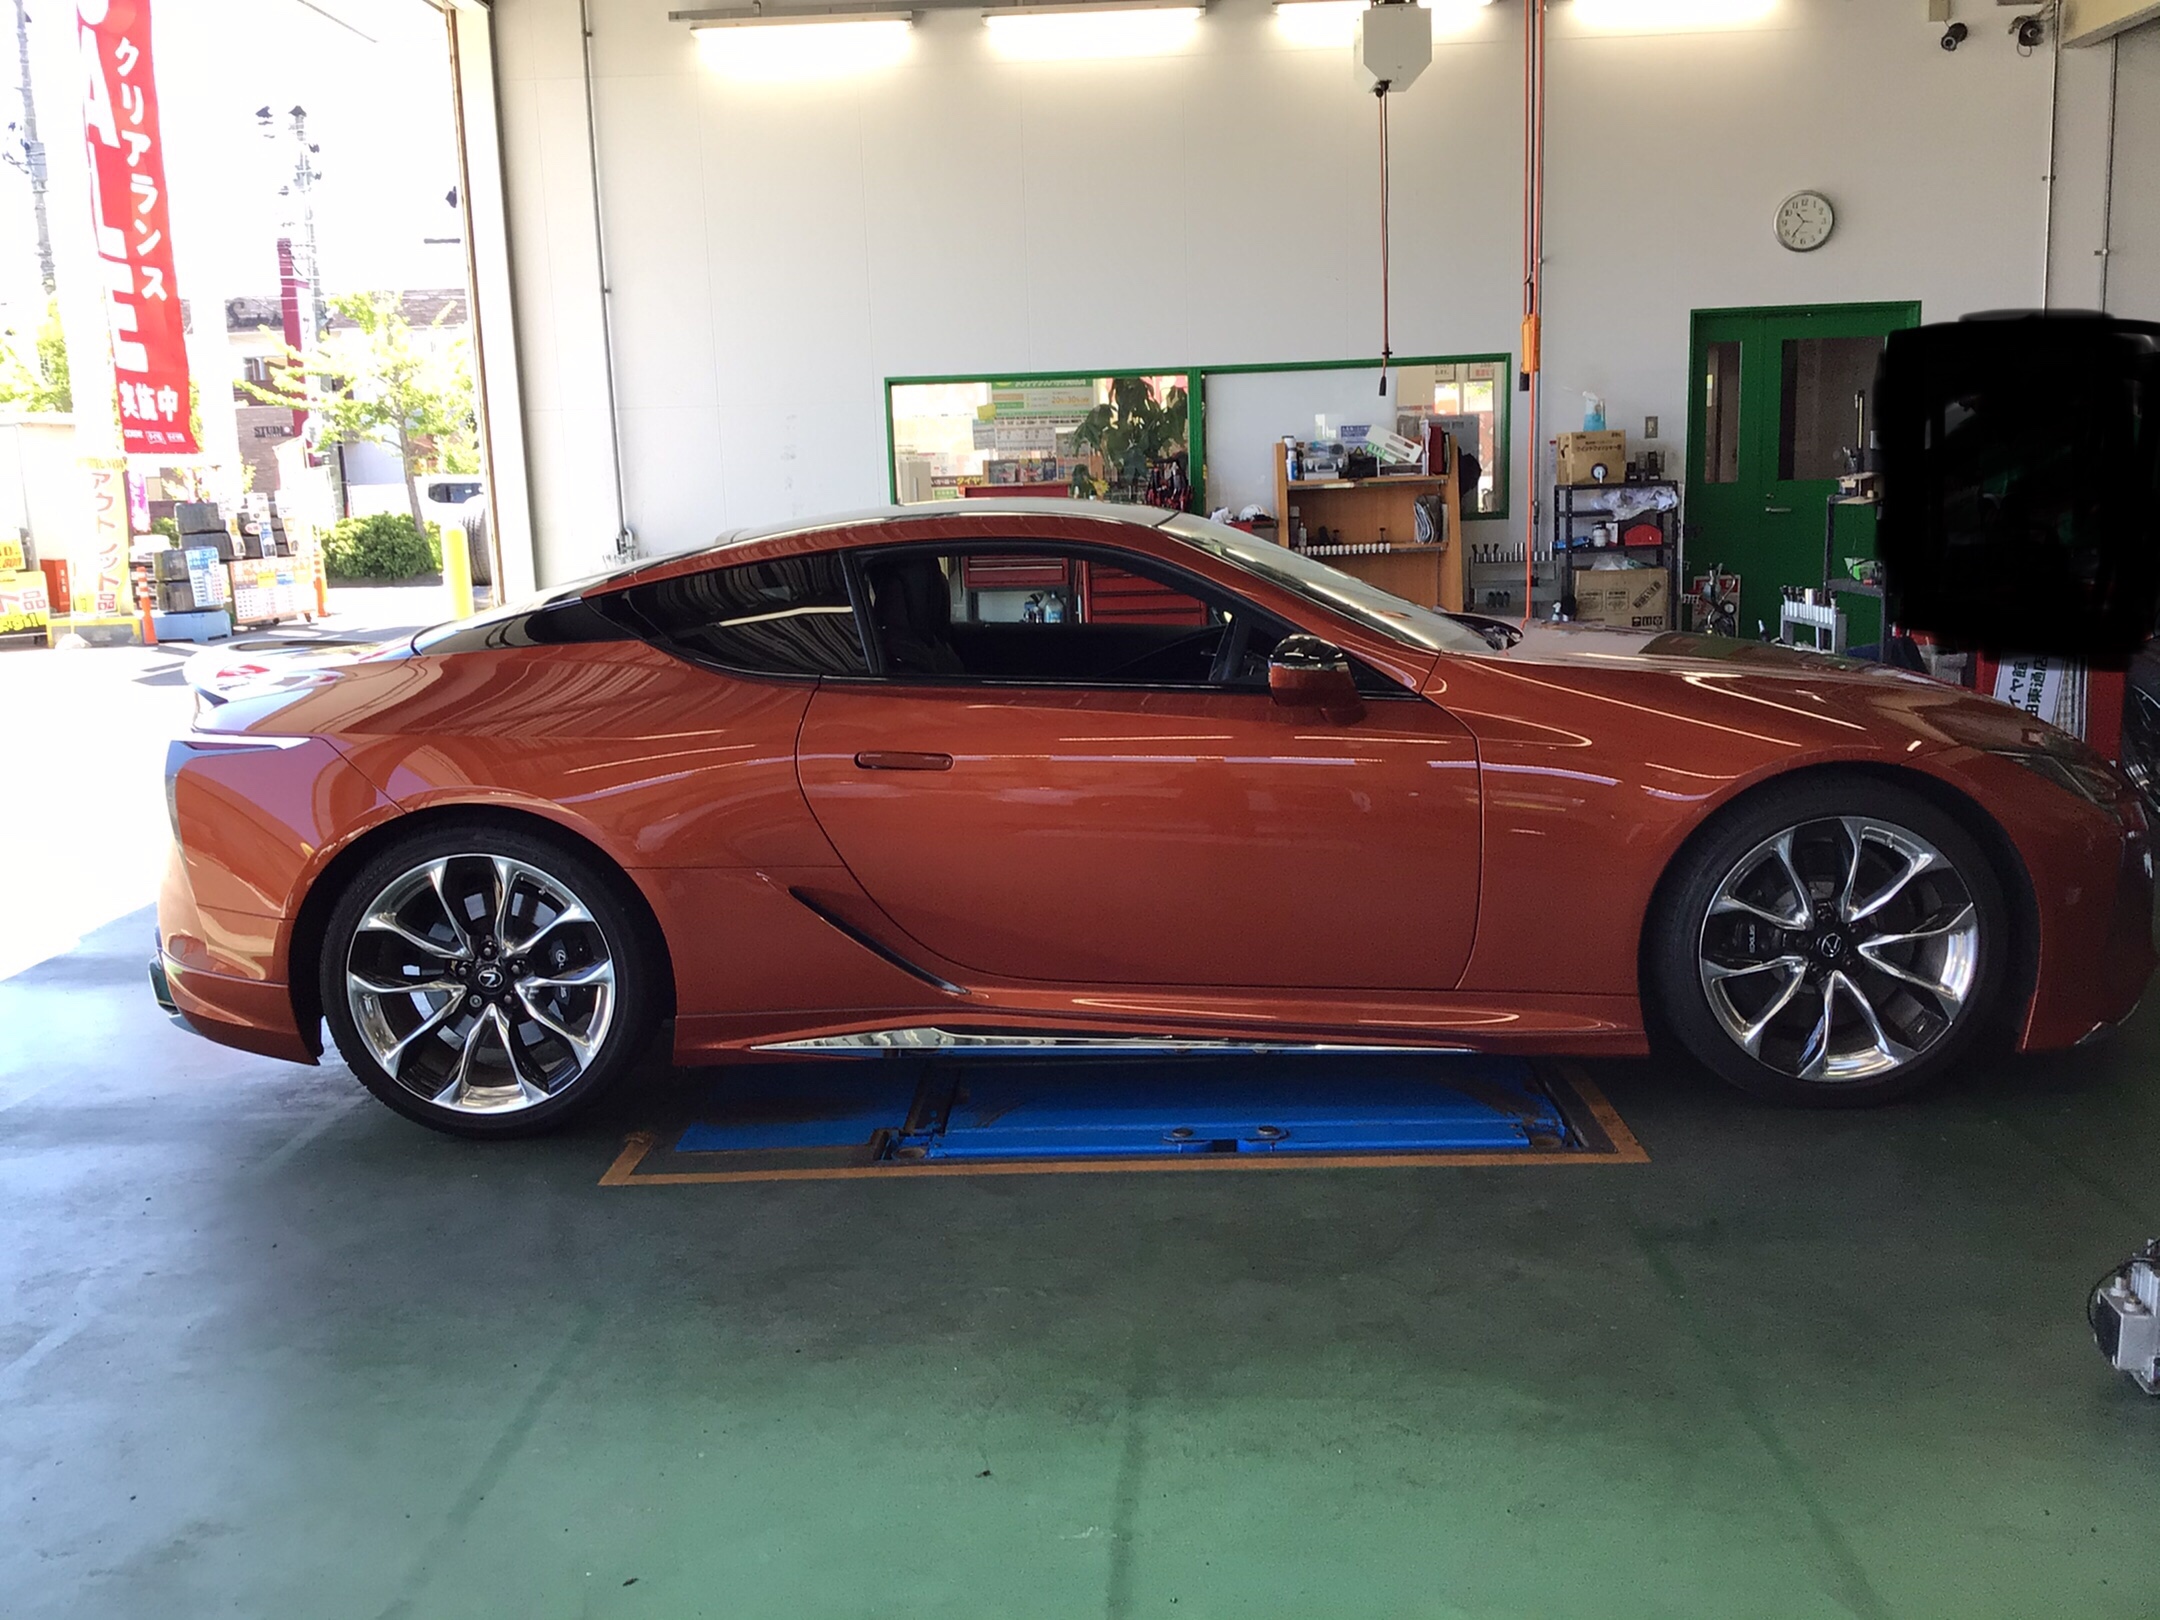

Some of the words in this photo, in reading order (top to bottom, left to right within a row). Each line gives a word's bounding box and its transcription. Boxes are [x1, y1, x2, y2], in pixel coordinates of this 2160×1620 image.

[115, 36, 168, 301] クリアランス
[118, 380, 179, 422] 実施中
